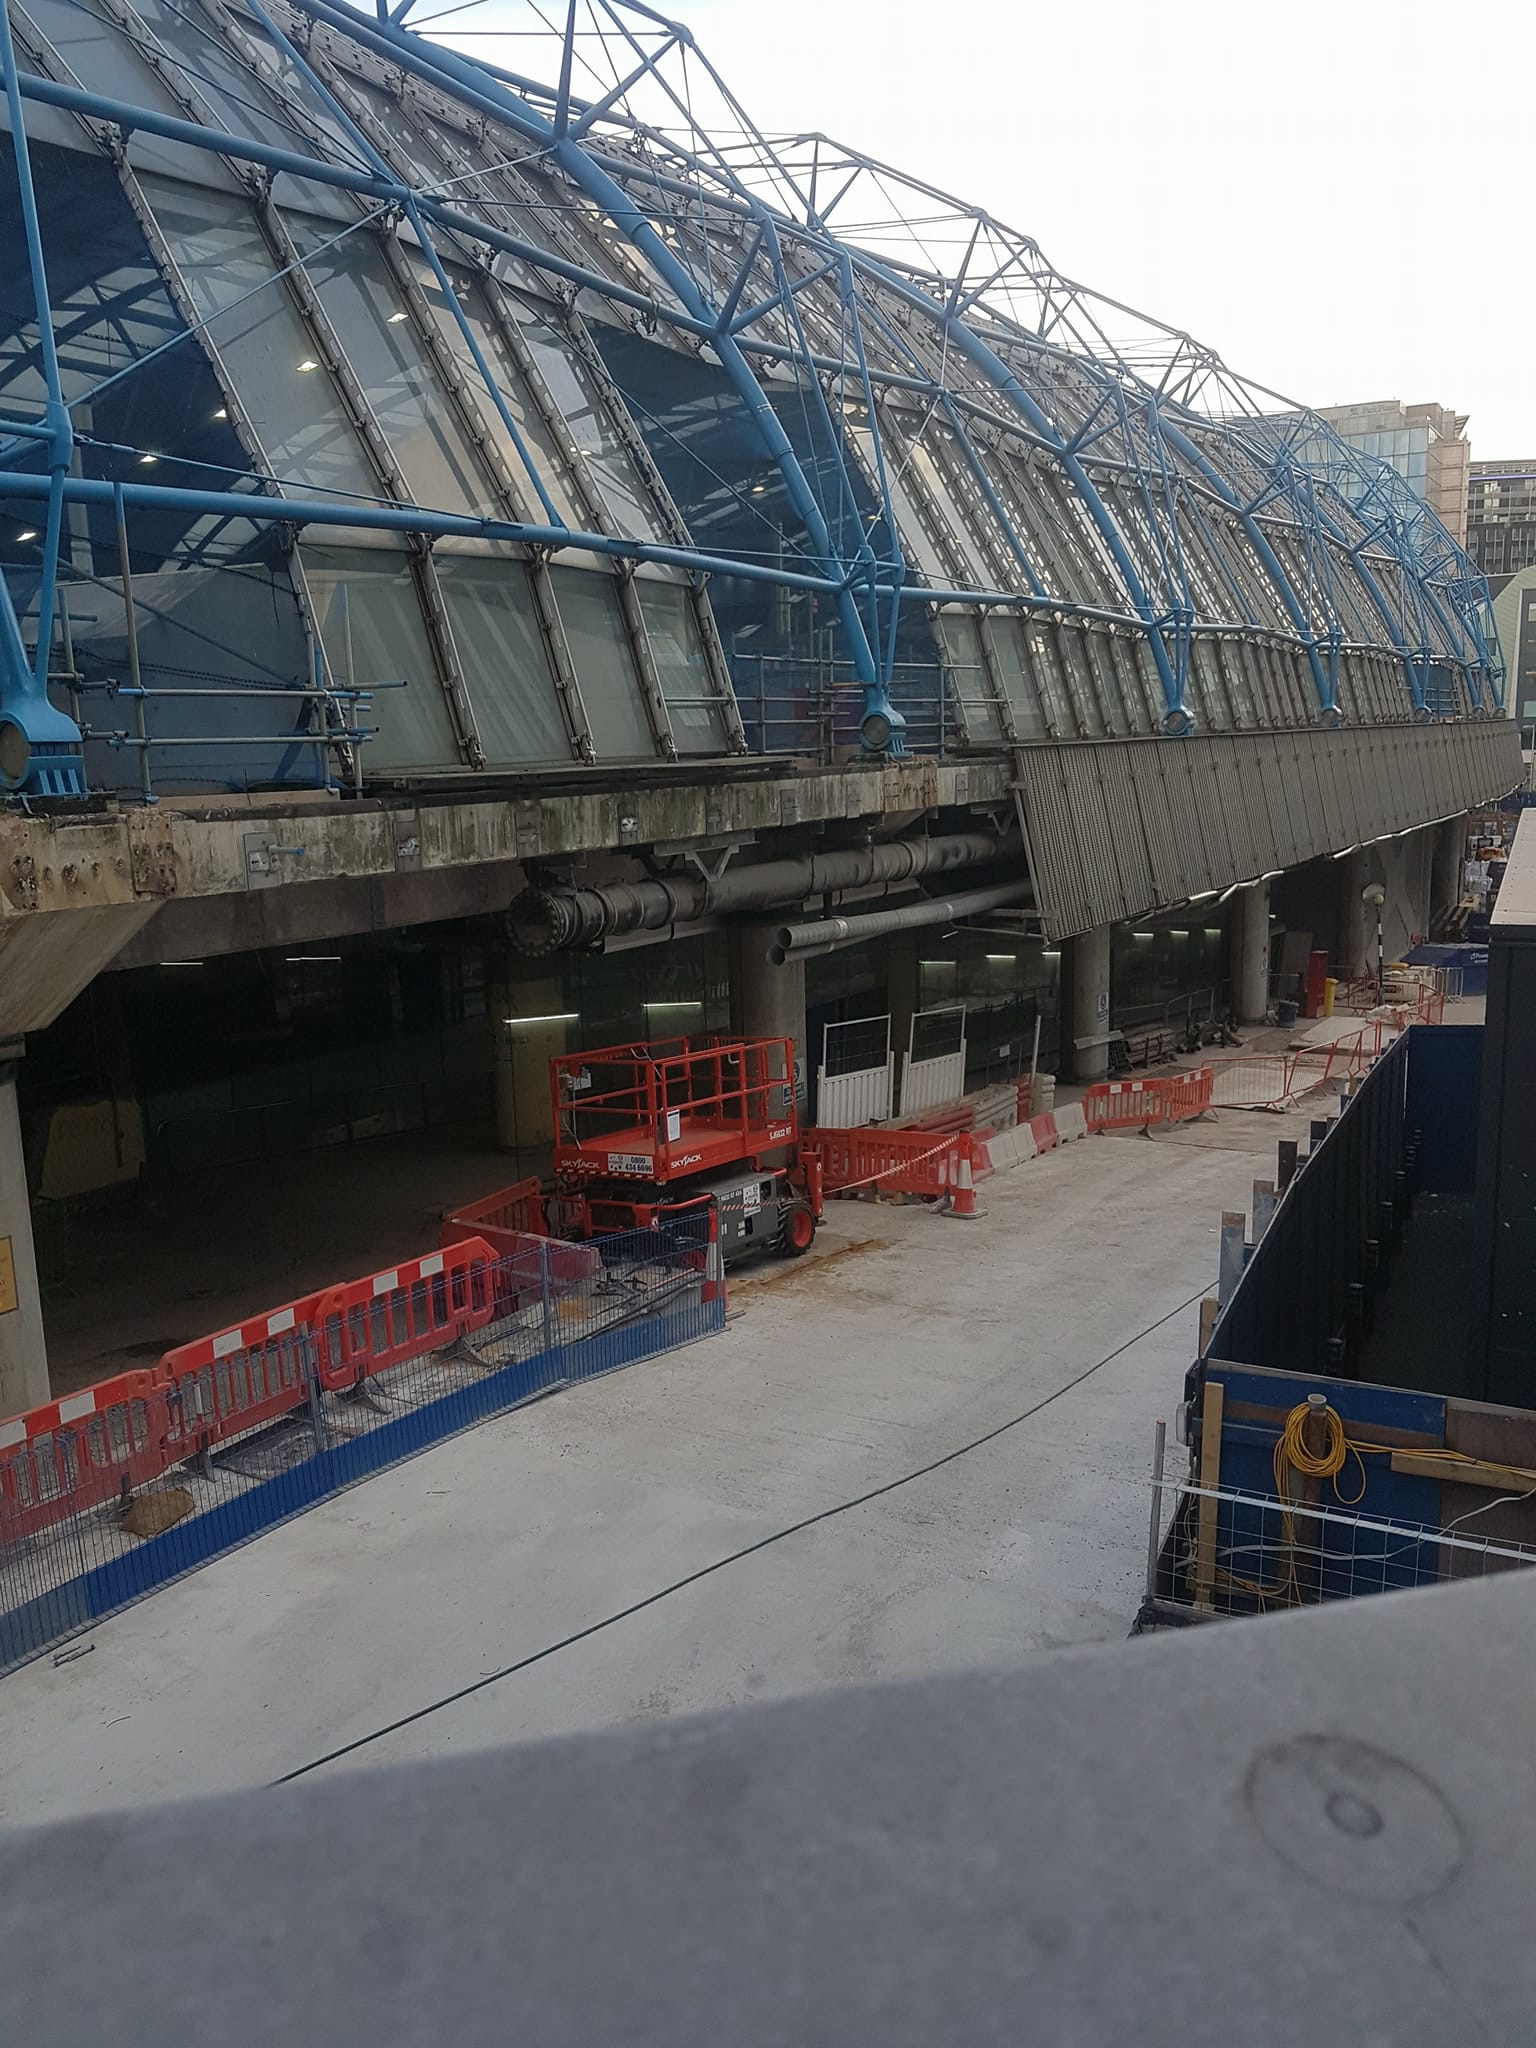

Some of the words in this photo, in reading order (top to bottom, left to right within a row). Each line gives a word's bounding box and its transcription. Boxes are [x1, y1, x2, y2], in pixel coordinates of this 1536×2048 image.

[561, 1158, 600, 1168] SKYJACK
[630, 1156, 646, 1164] 0800
[671, 1153, 702, 1169] SKYJACK
